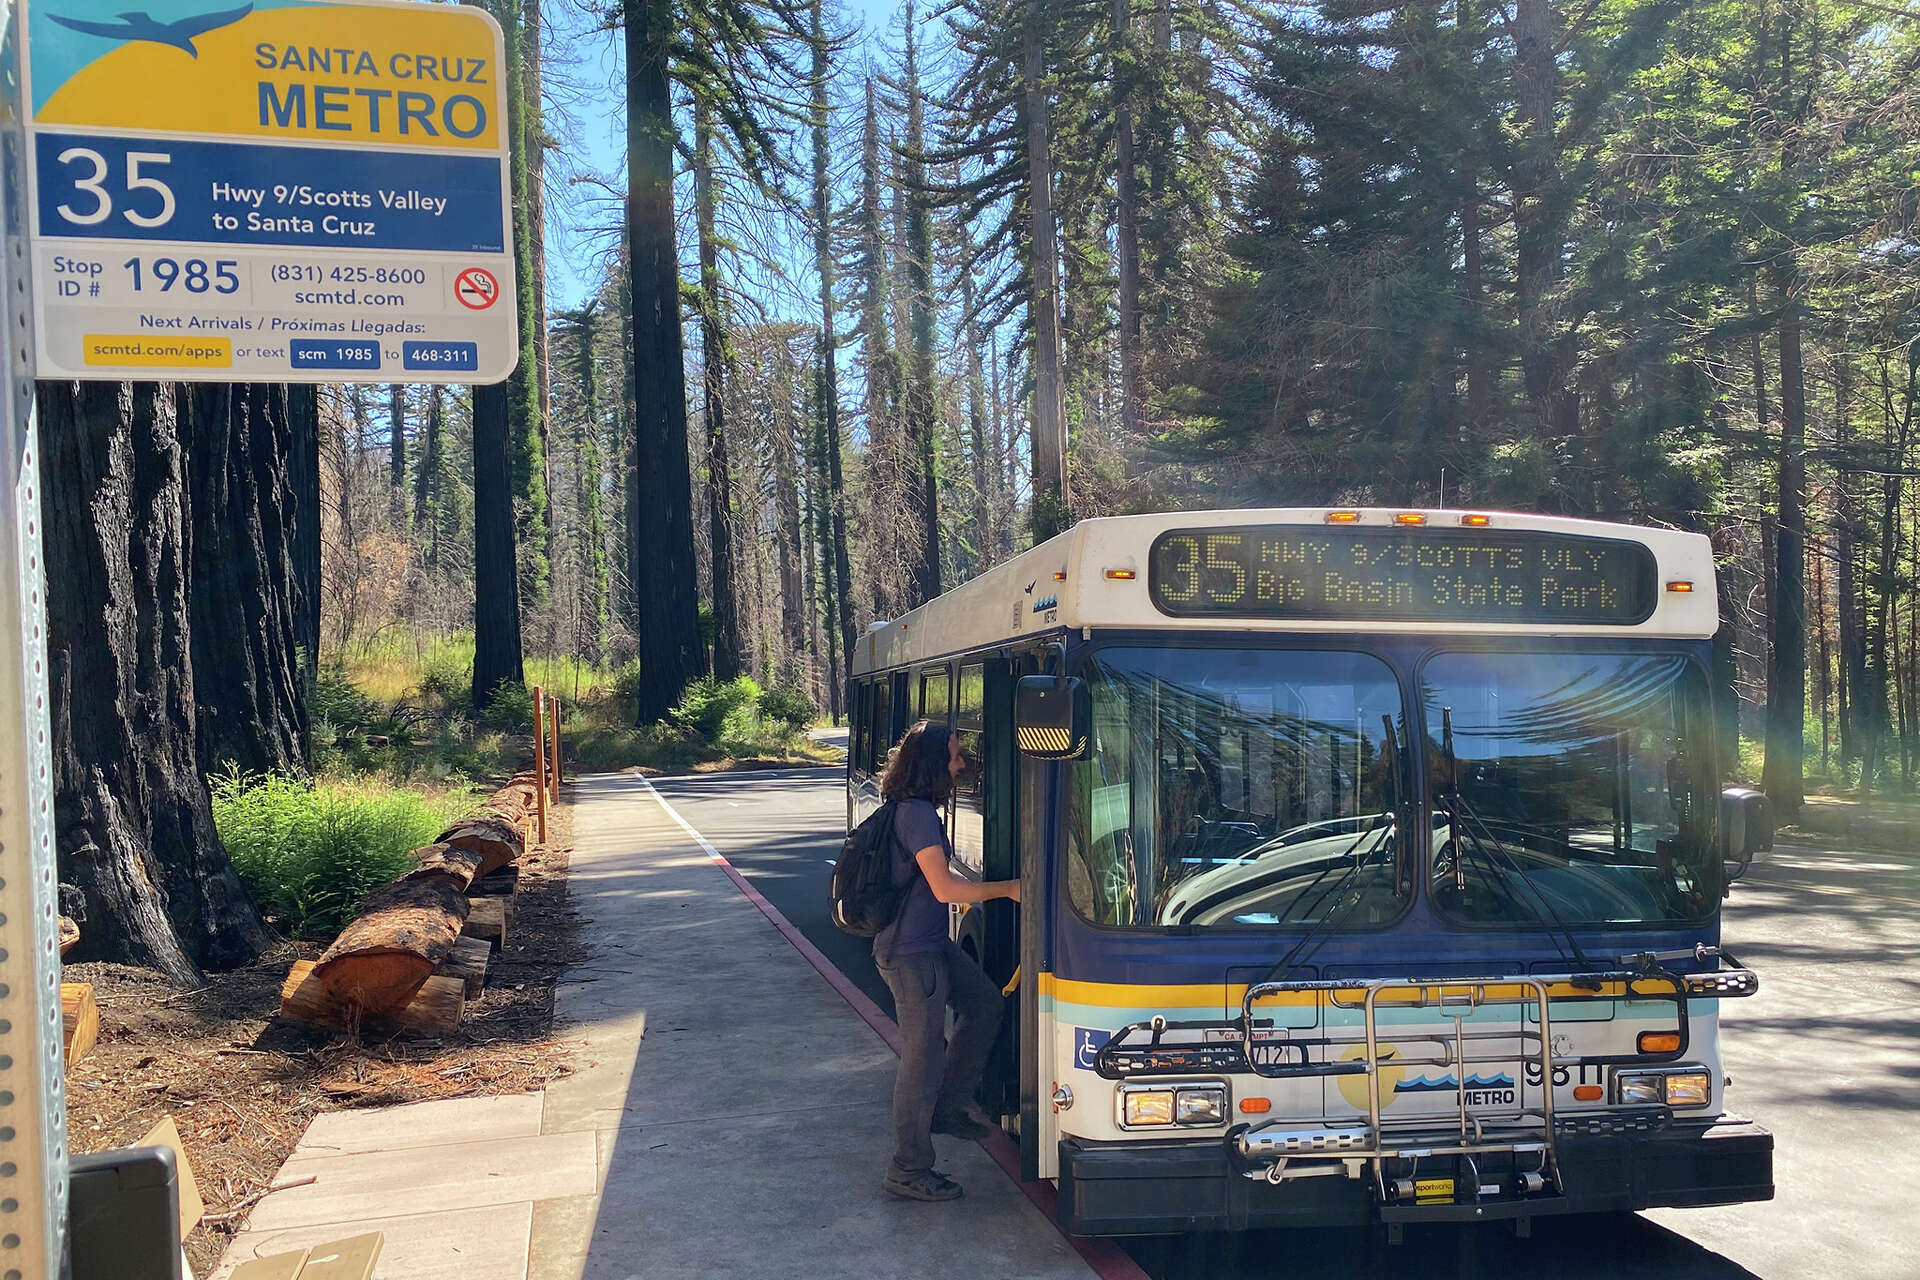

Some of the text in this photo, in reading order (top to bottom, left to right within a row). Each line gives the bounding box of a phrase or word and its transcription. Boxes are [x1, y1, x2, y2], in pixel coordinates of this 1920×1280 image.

[255, 43, 487, 84] SANTA CRUZ
[258, 81, 487, 139] METRO
[57, 148, 176, 227] 35
[212, 182, 447, 215] Hwy 9/Scotts Valley
[212, 213, 375, 236] to Santa Cruz
[54, 256, 103, 277] Stop
[123, 257, 239, 294] 1985
[271, 264, 426, 285] (831) 425-8600
[58, 280, 100, 297] ID #
[295, 290, 405, 306] scmtd.com
[140, 314, 426, 335] Next Arrivals / Próximas Llegadas:
[94, 343, 469, 362] scmtd.com/apps or text scm 1985 to 468-311
[1262, 541, 1606, 571] HWY 9/SCOTTS VLY
[1160, 535, 1246, 603] 35
[1325, 571, 1413, 607] Basin
[1432, 574, 1524, 606] State
[1541, 577, 1617, 608] Park
[1224, 1031, 1269, 1040] CA EMPT
[1456, 1090, 1515, 1106] METRO
